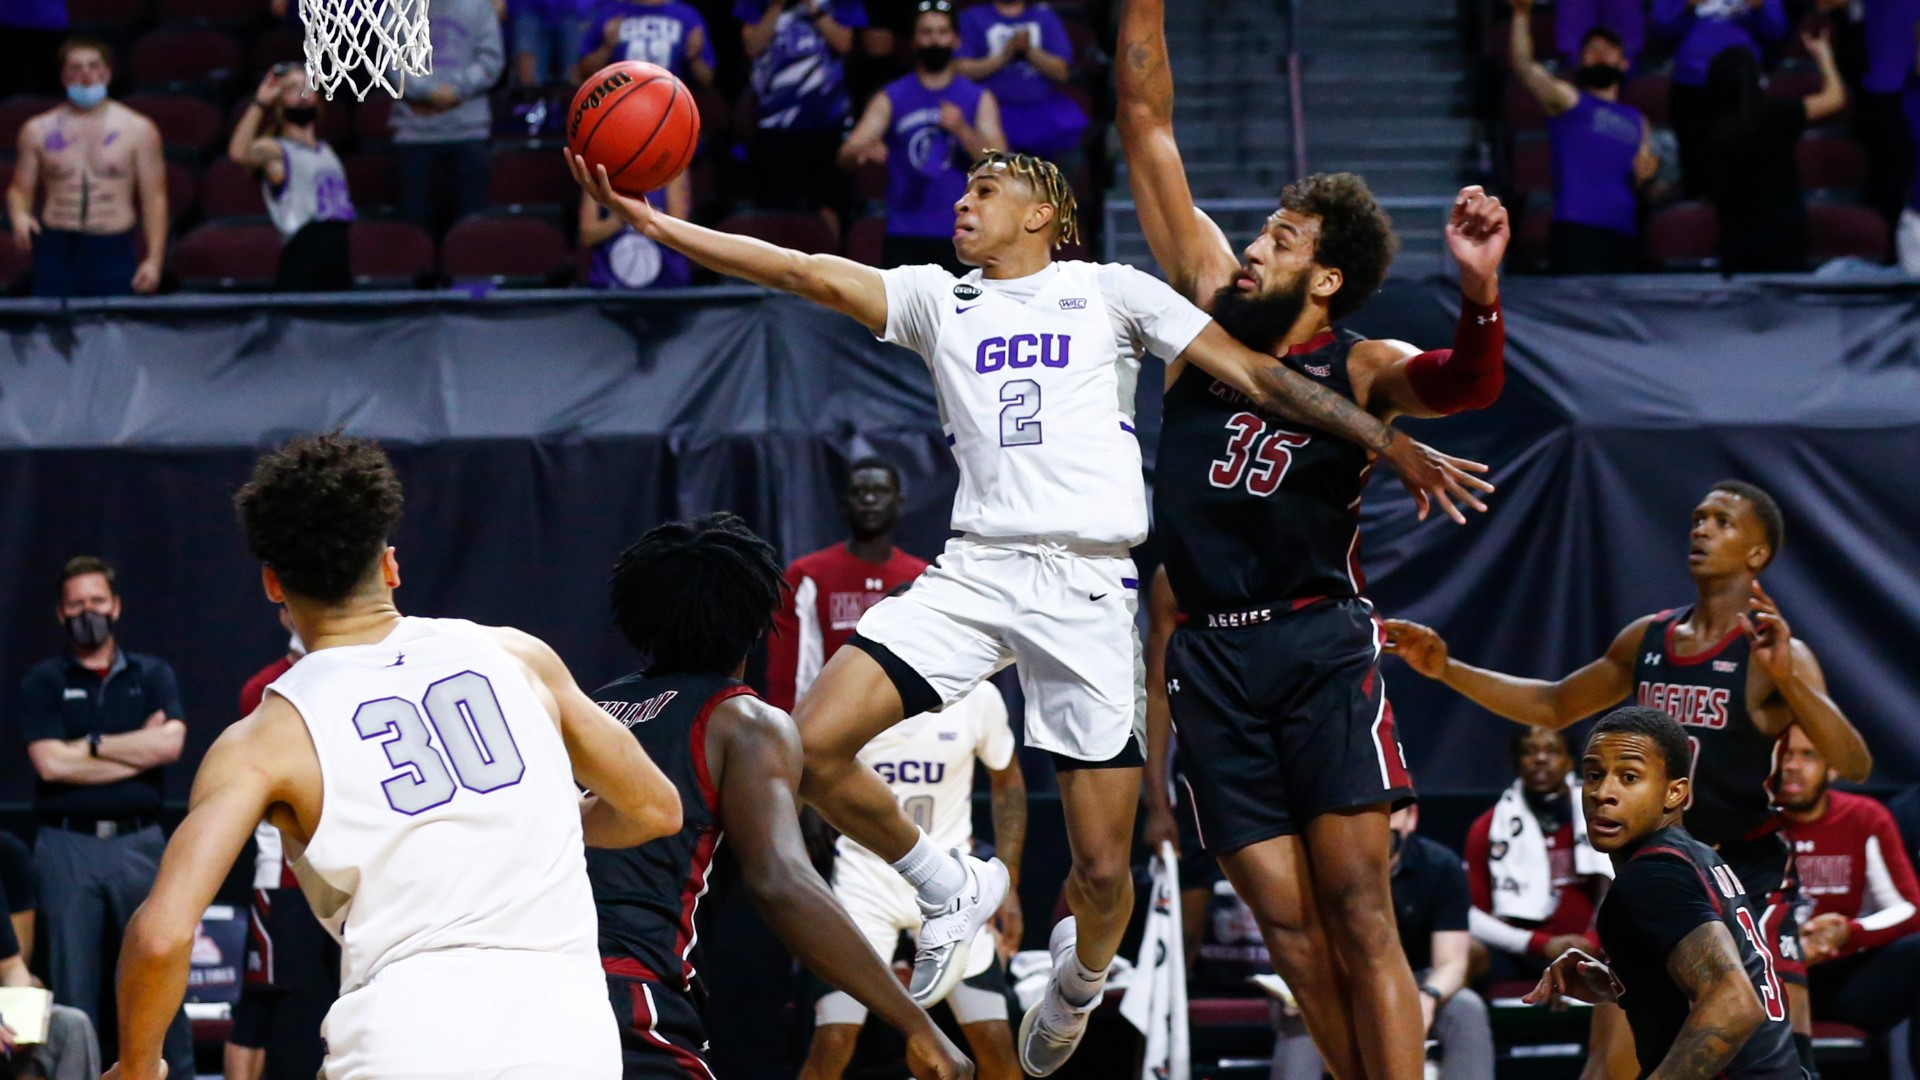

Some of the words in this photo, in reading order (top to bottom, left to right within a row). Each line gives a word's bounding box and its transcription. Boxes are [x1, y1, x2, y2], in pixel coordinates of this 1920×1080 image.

[570, 71, 633, 140] Wilson
[1060, 299, 1087, 310] WAC
[975, 333, 1071, 374] GCU
[999, 378, 1042, 448] 2
[1209, 412, 1312, 497] 35
[1208, 609, 1272, 628] AGGIES
[1638, 681, 1731, 730] AGGIES
[352, 670, 525, 816] 30
[874, 761, 945, 785] GCU
[1736, 906, 1785, 1022] 3
